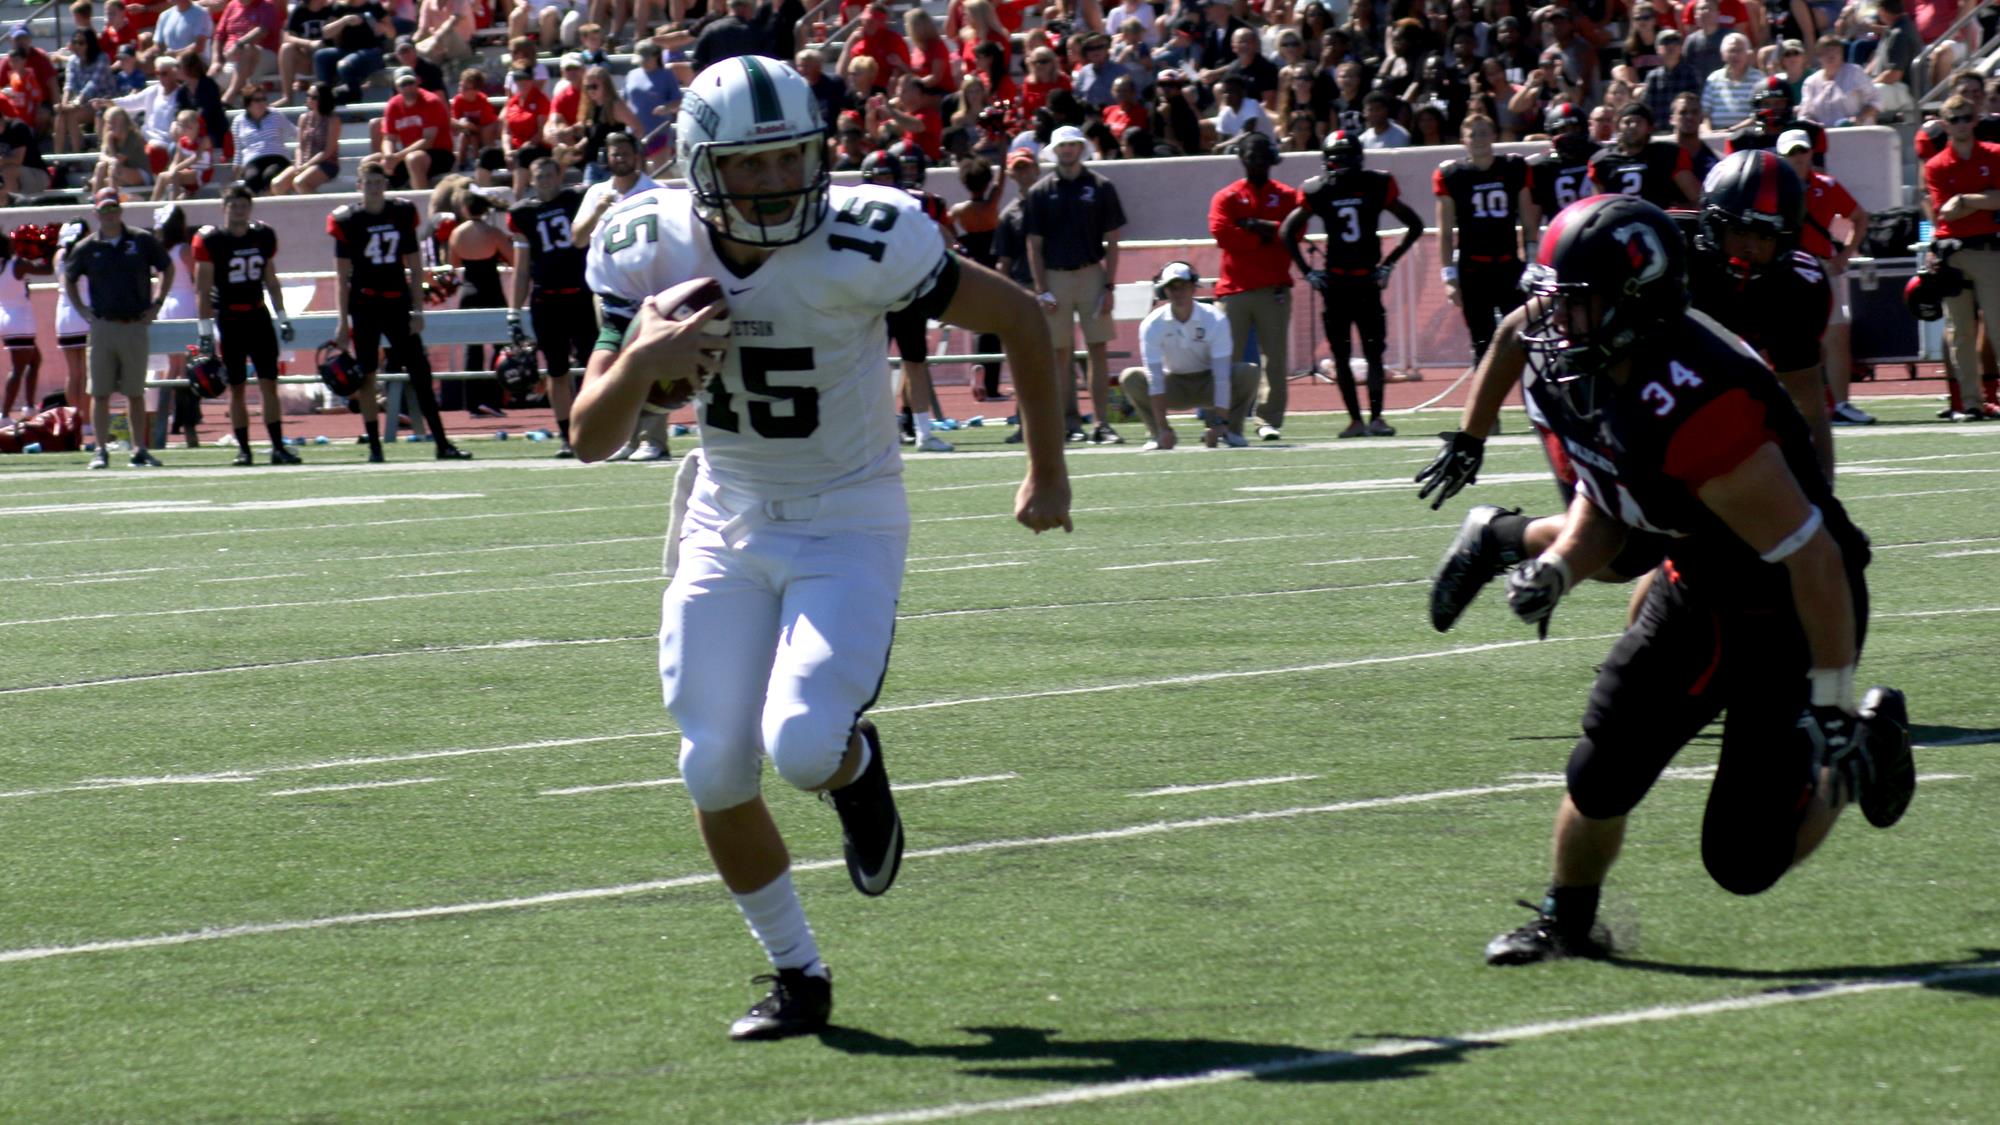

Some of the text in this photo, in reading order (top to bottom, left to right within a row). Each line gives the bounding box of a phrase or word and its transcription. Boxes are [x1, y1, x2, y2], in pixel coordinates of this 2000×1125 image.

[1621, 172, 1642, 195] 2
[1471, 191, 1508, 218] 10
[537, 215, 572, 252] 13
[828, 197, 900, 262] 15
[1338, 207, 1360, 241] 3
[364, 232, 400, 264] 47
[228, 255, 264, 283] 26
[733, 321, 774, 336] ETSON
[1641, 360, 1703, 415] 34
